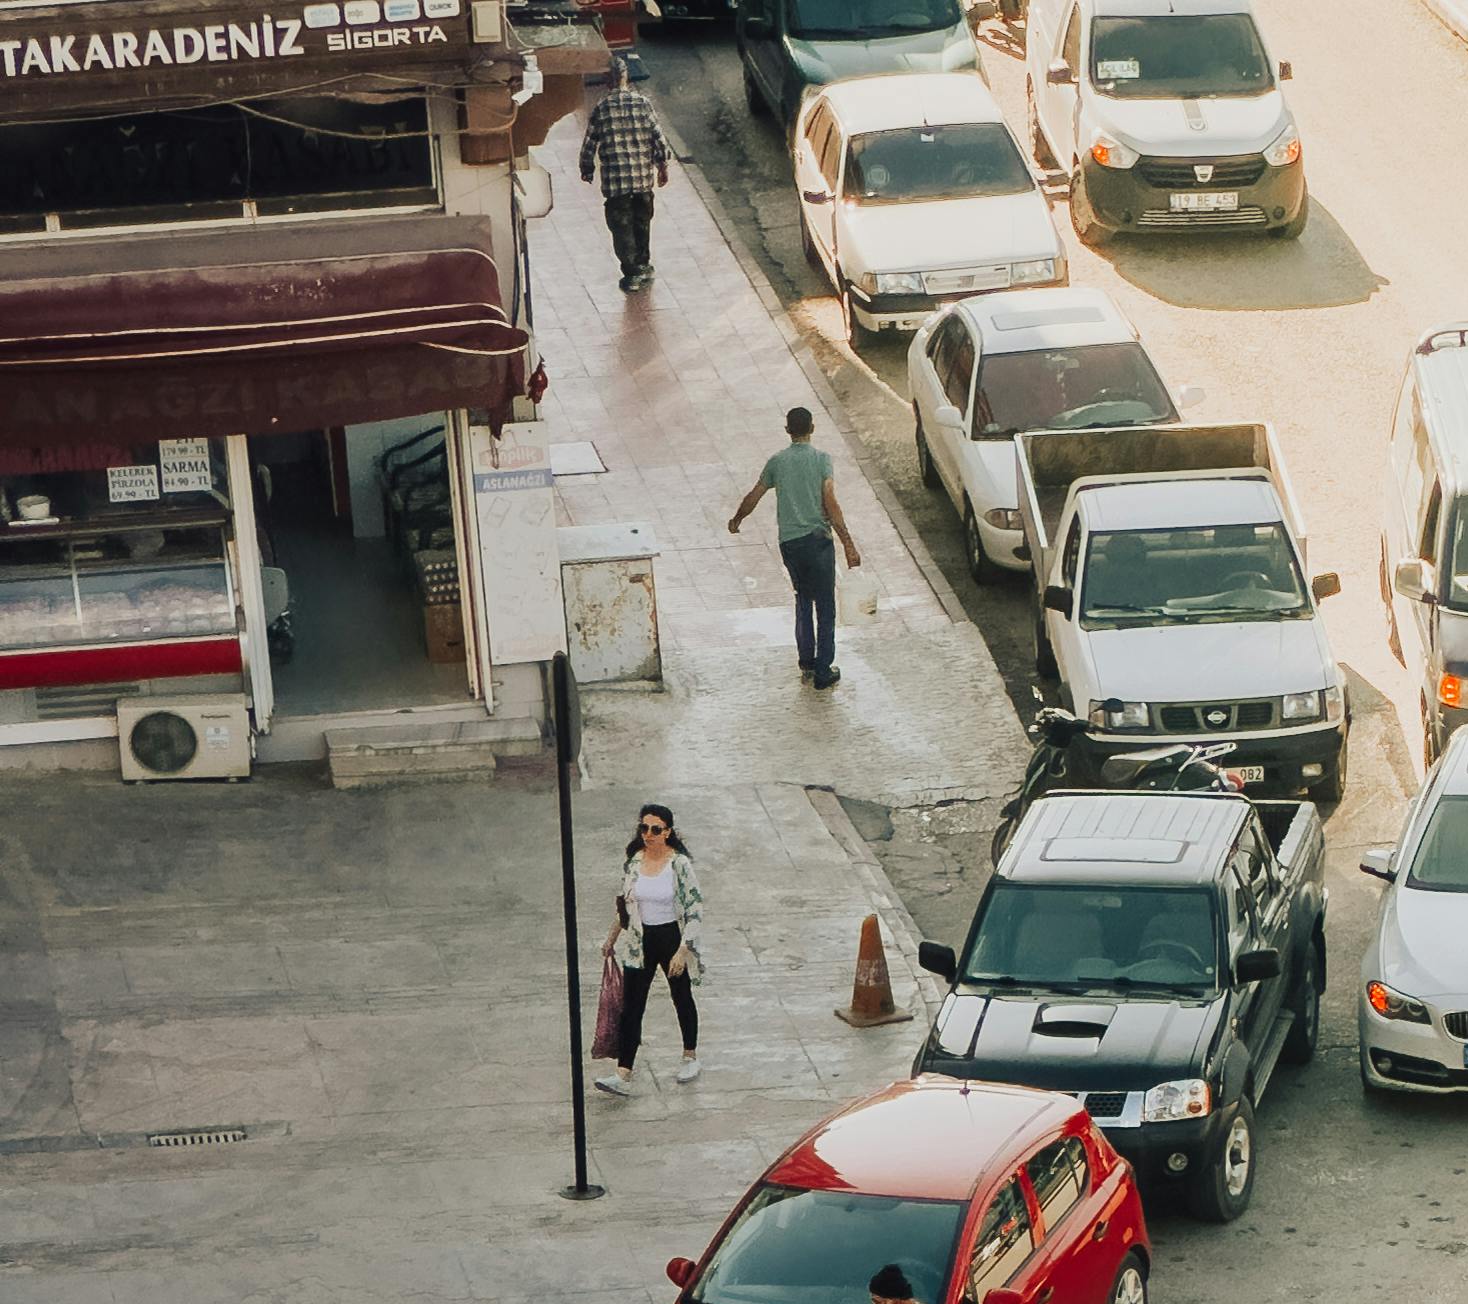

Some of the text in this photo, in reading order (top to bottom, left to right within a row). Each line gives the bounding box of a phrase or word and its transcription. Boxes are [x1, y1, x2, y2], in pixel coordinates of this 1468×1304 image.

[327, 26, 447, 51] SİGORTA
[1177, 196, 1190, 206] 19
[163, 460, 208, 473] SARMA
[198, 476, 209, 485] TL
[483, 473, 544, 489] ASLANAĞZI
[1240, 768, 1263, 781] 082
